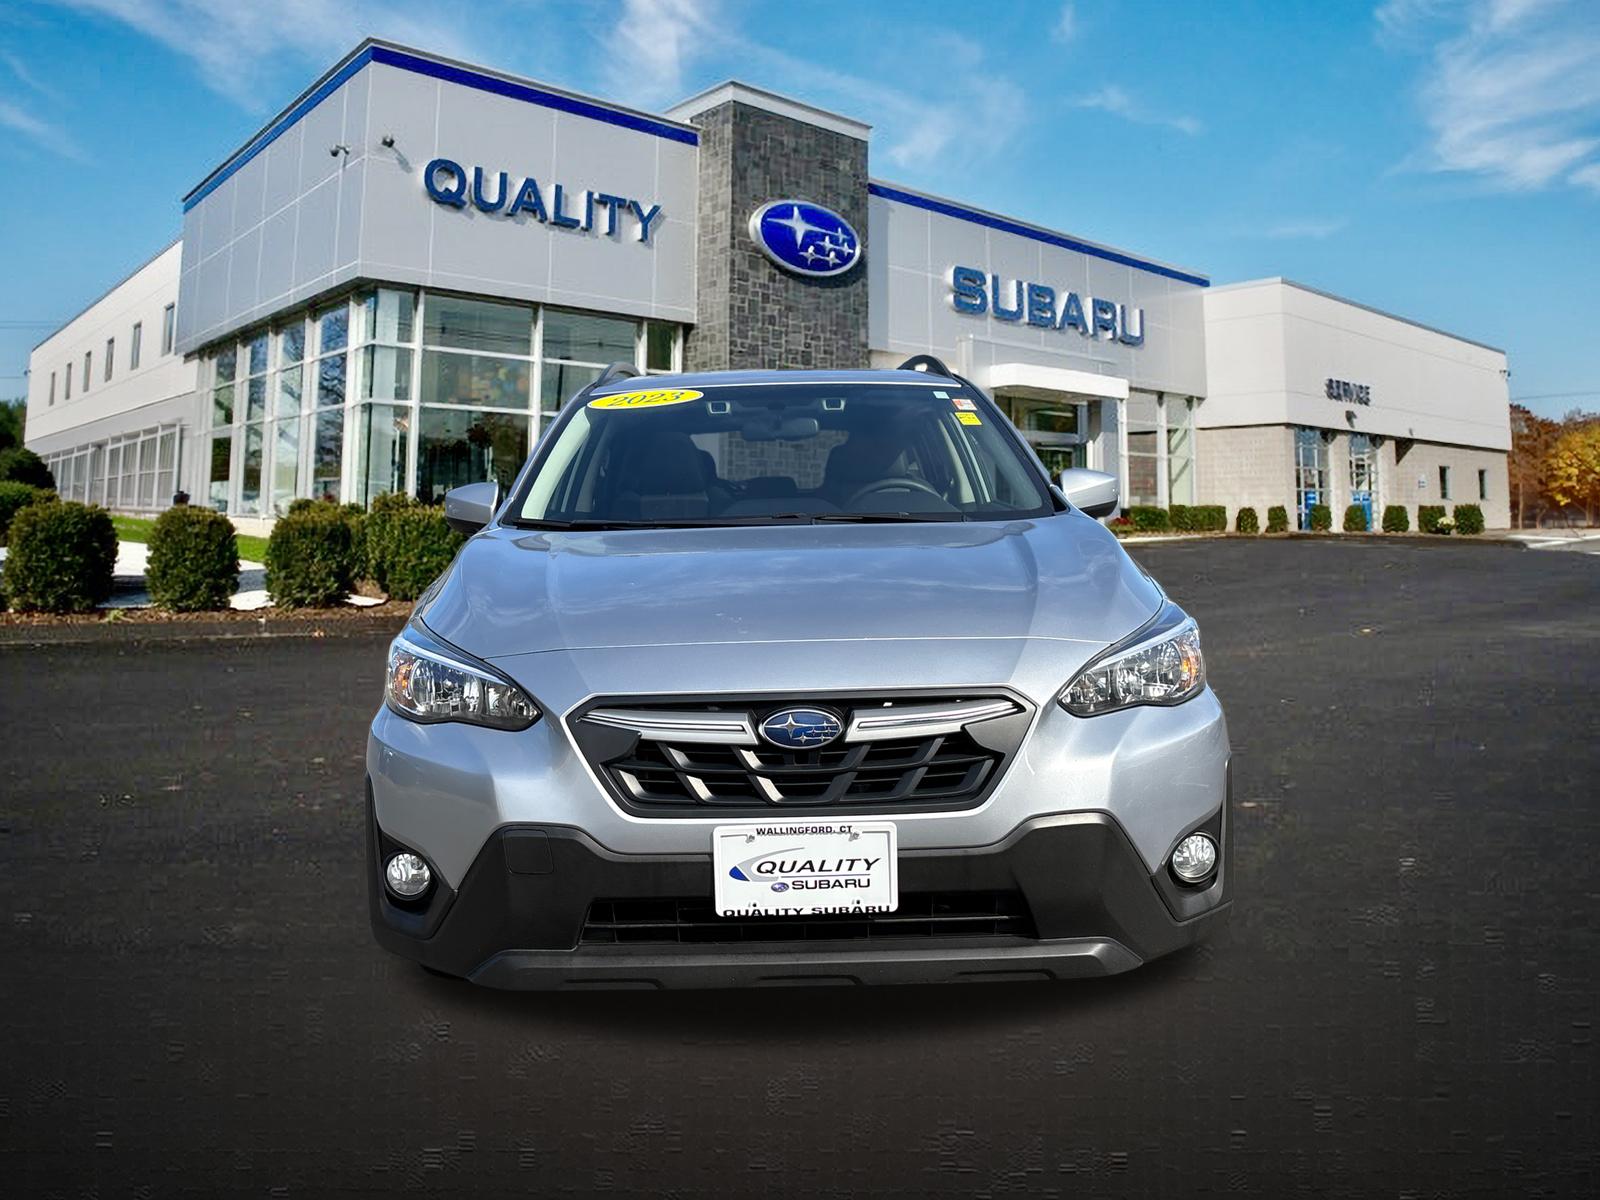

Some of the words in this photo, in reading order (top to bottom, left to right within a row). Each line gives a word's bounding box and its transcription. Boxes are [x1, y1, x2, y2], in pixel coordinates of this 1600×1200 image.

[424, 158, 664, 243] QUALITY
[947, 265, 1146, 347] SUBARU
[607, 391, 685, 407] 2023
[1325, 378, 1371, 406] SERVICE
[840, 825, 853, 834] CT
[756, 858, 881, 875] QUALITY
[791, 878, 870, 890] SUBARU
[723, 906, 804, 917] QUALITY
[811, 905, 890, 915] SUBARU
